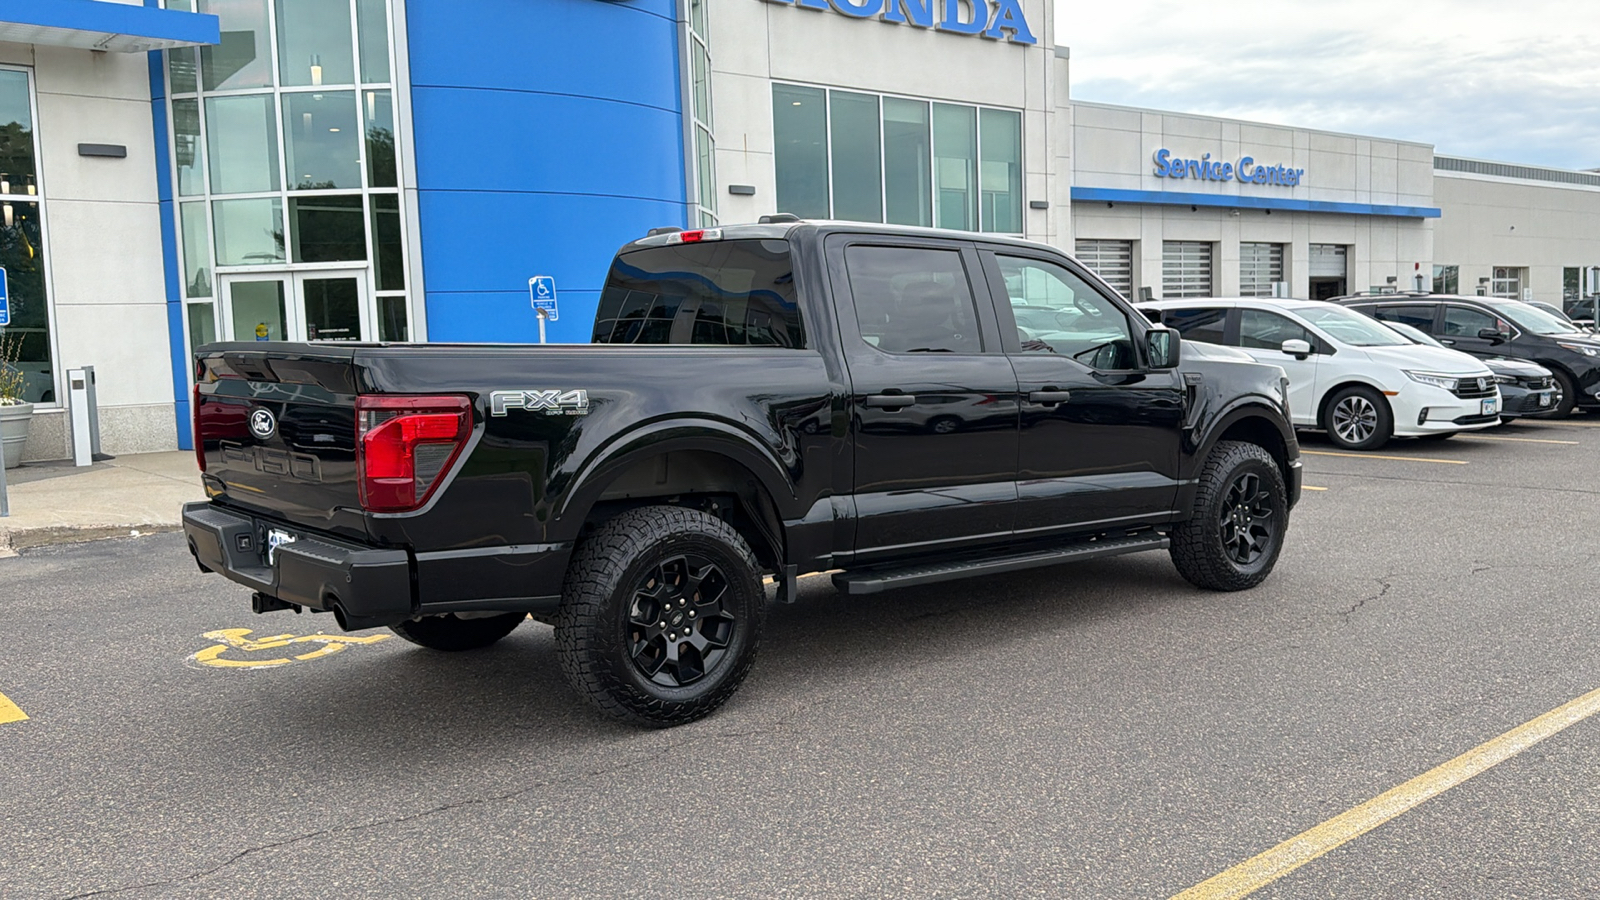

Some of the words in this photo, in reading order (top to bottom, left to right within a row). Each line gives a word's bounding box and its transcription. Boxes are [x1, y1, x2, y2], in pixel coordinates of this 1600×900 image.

[757, 0, 1038, 45] NDA
[1153, 148, 1234, 182] Service
[1236, 156, 1305, 187] Center
[489, 389, 589, 417] FX4
[253, 411, 272, 433] Ford
